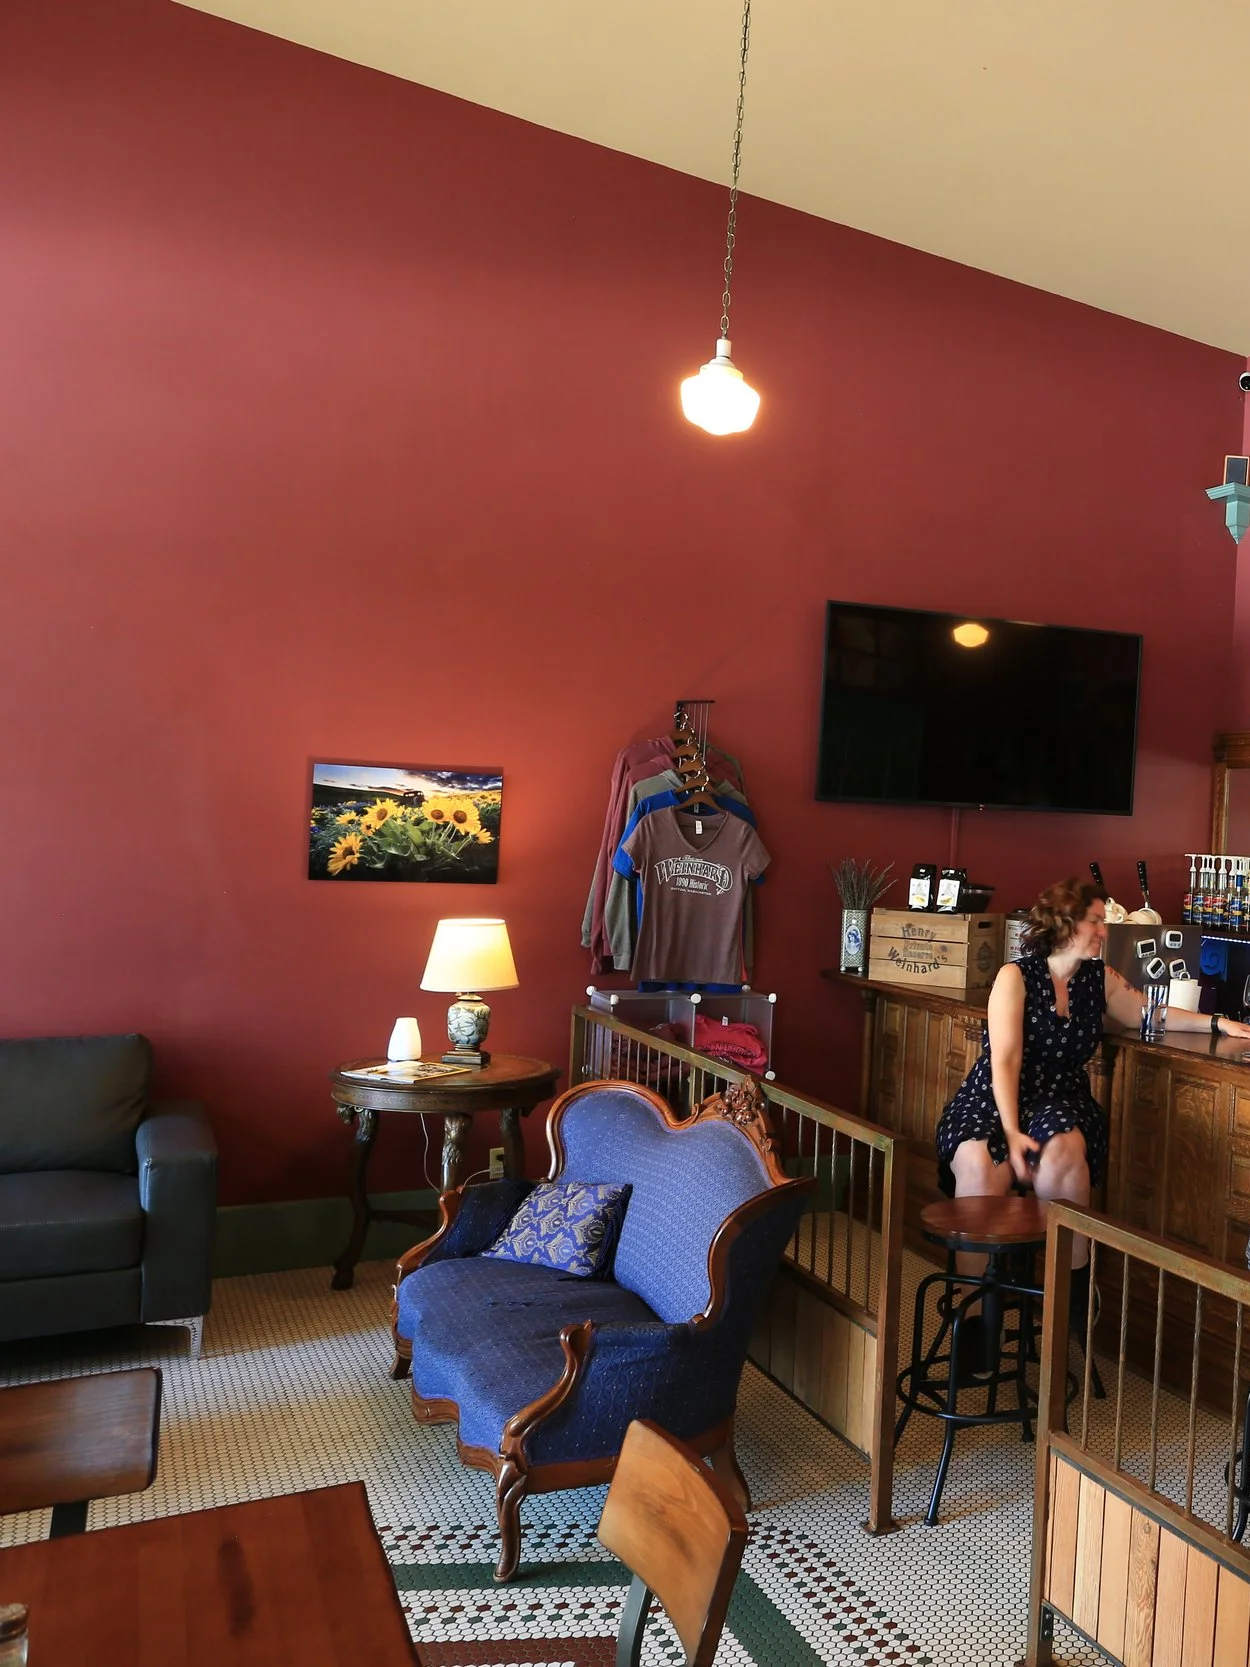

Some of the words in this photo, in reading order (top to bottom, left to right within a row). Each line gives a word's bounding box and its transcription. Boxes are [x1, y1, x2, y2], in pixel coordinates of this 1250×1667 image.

[654, 858, 733, 891] WEINHARD
[902, 926, 936, 941] Henry
[888, 946, 948, 974] Weinhard's
